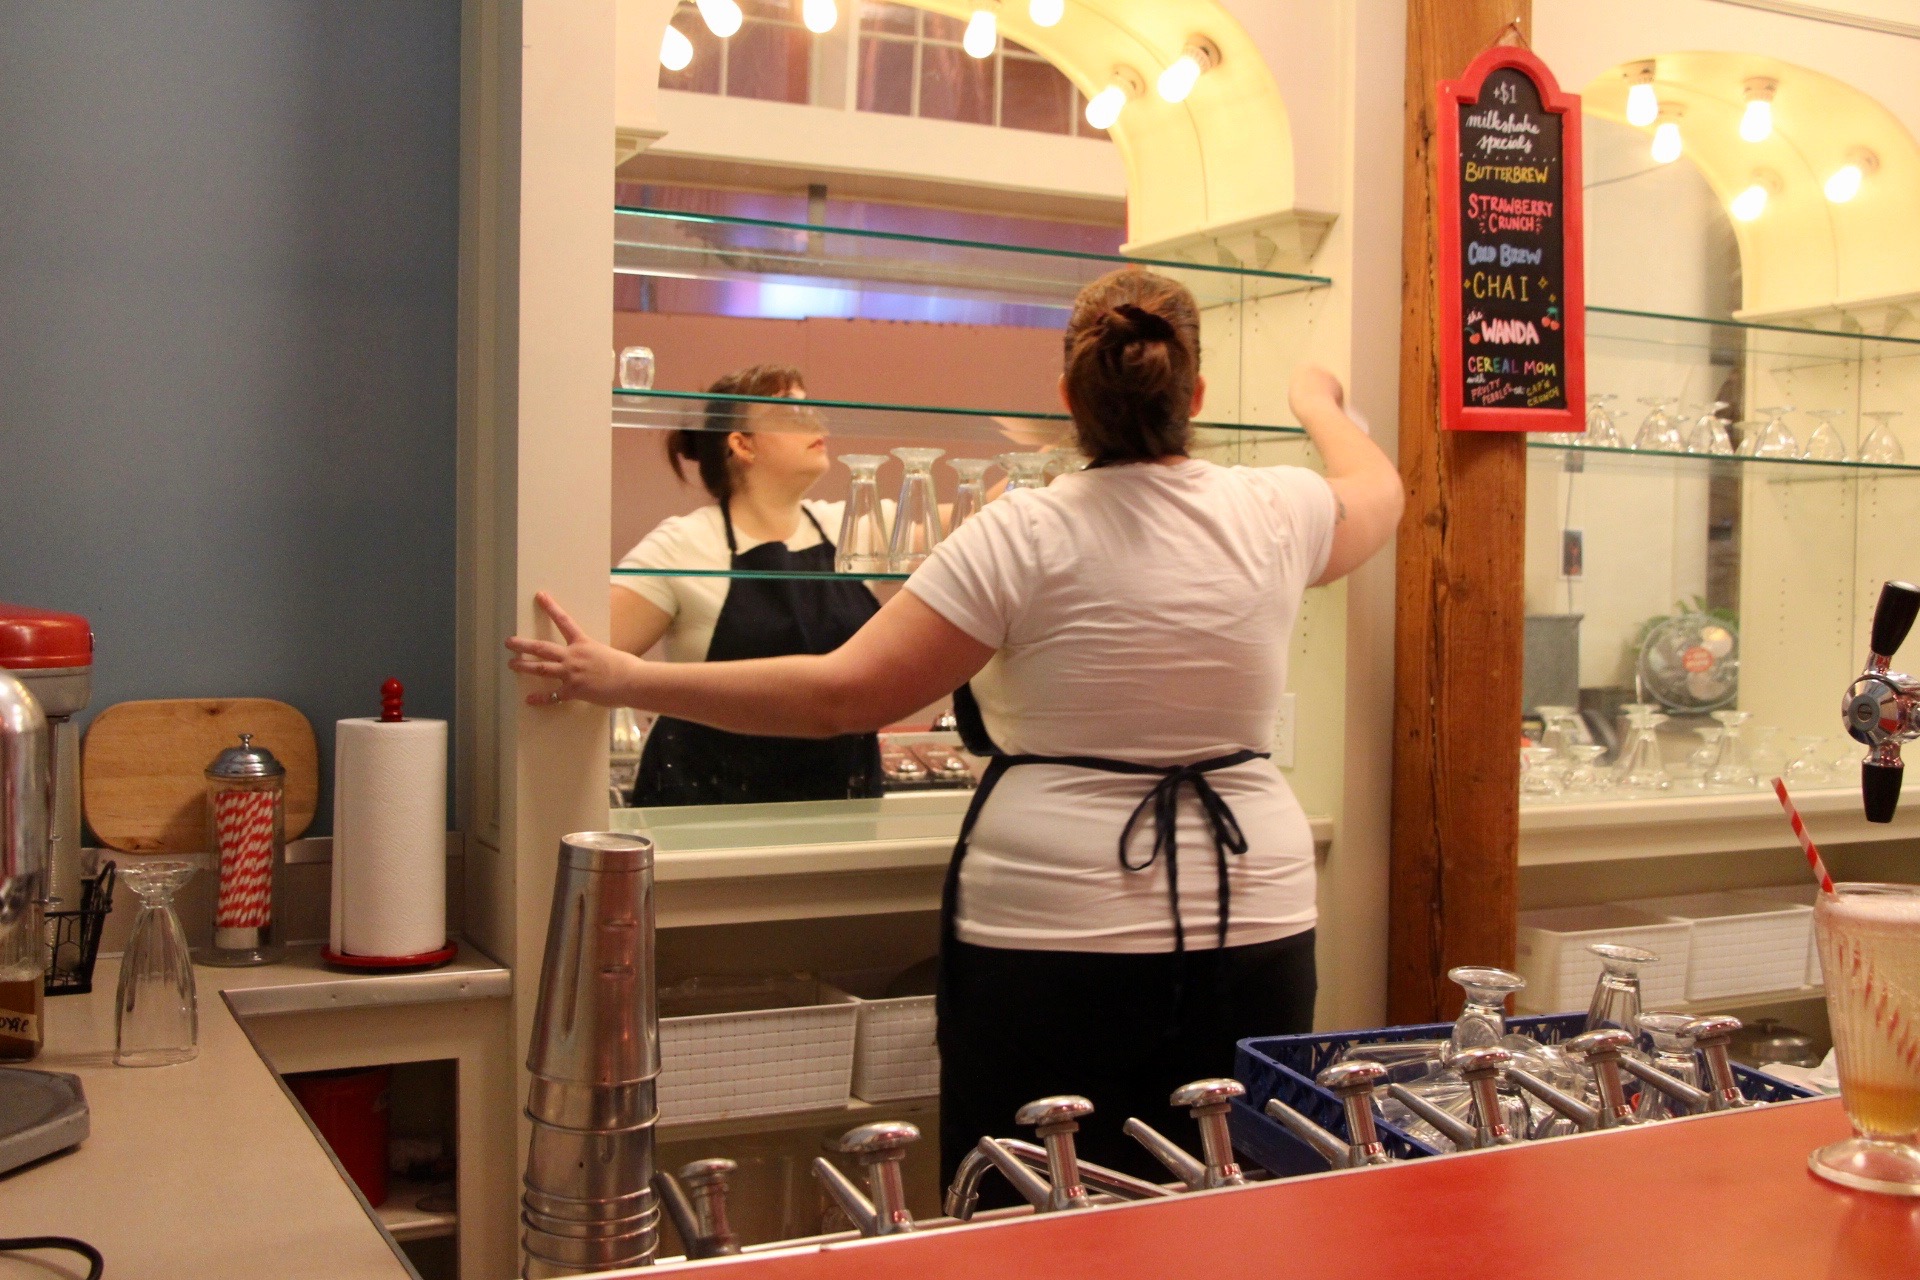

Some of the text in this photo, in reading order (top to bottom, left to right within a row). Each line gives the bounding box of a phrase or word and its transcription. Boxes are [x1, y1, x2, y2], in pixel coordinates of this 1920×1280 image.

[1465, 110, 1541, 135] milkshake
[1476, 134, 1533, 154] specials
[1464, 161, 1548, 184] BUTTERBREW
[1468, 193, 1553, 218] STRAWBERRY
[1488, 212, 1536, 233] CRUNCH
[1499, 243, 1543, 268] BREW
[1473, 271, 1530, 302] CHAI
[1481, 317, 1540, 346] WANDA
[1467, 355, 1557, 377] CEREAL MOM
